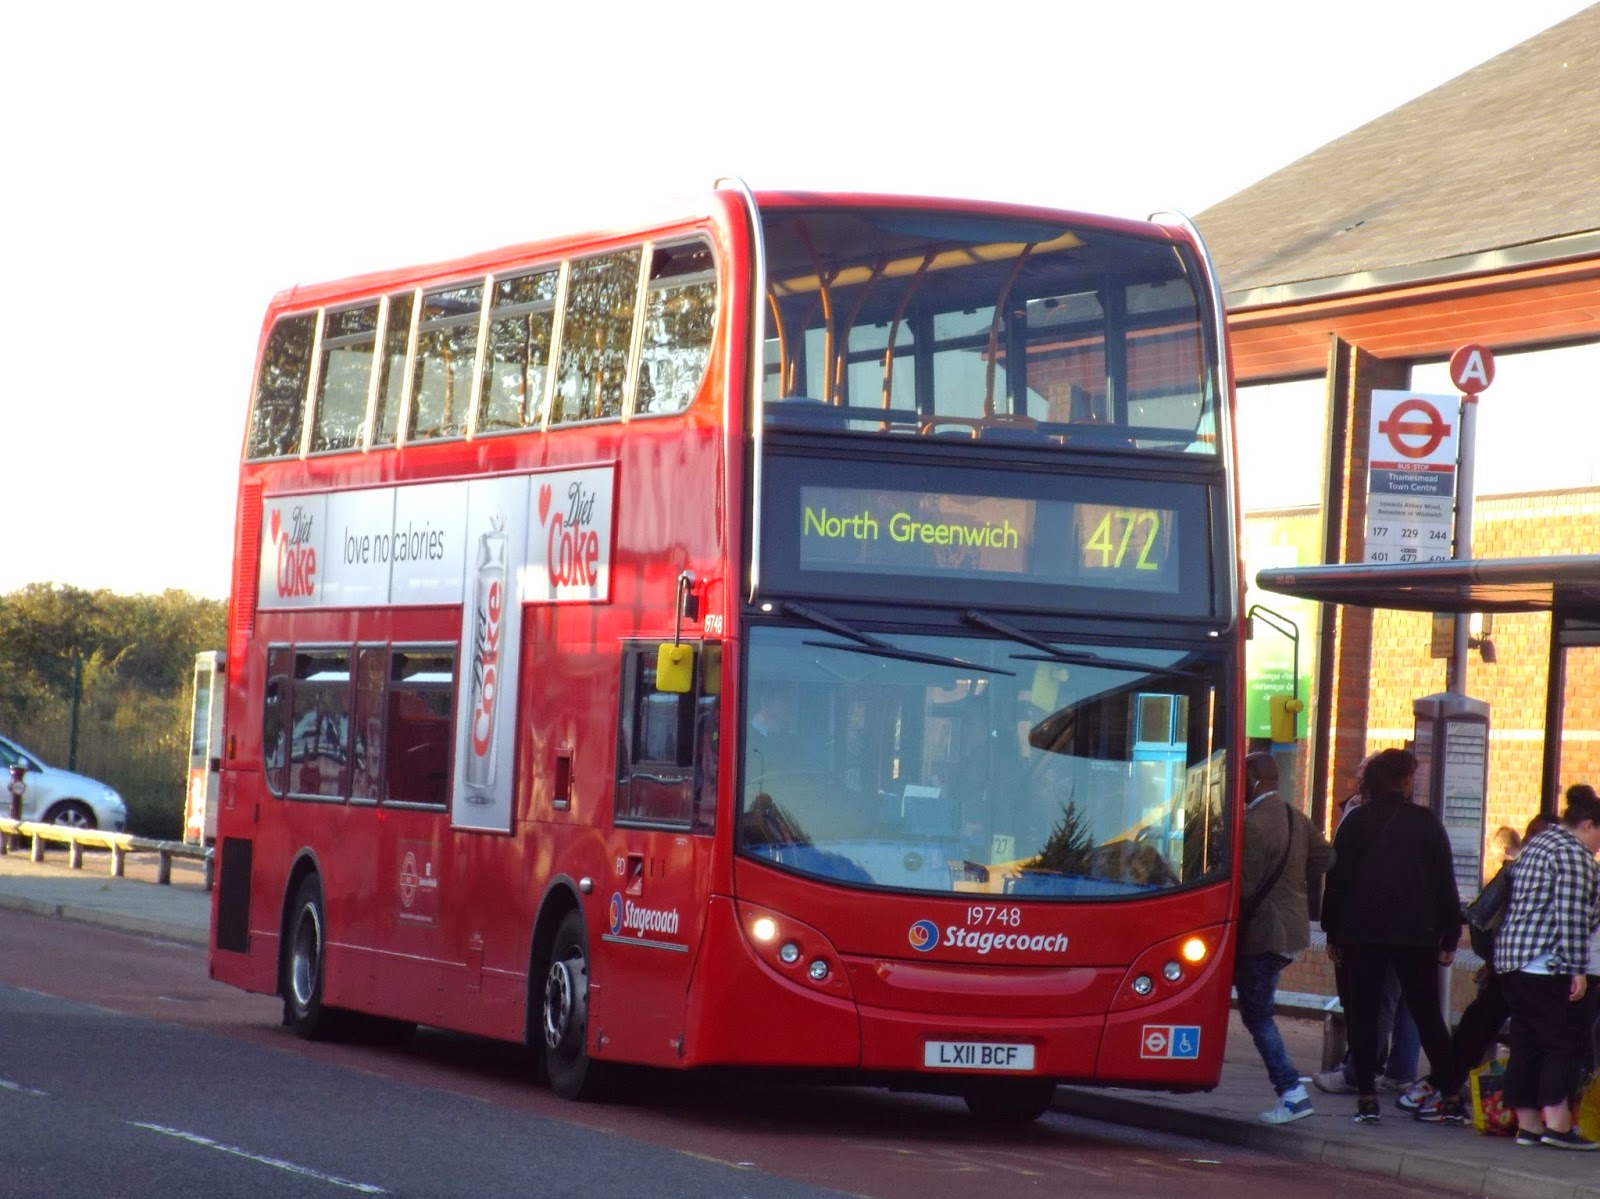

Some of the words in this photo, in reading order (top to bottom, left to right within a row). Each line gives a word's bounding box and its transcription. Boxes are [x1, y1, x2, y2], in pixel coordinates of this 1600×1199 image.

[1458, 350, 1489, 386] A
[1388, 473, 1439, 482] Thamesmead
[1388, 482, 1409, 490] Town
[1410, 483, 1437, 492] Centre
[563, 481, 596, 528] Diet
[289, 505, 313, 546] Diet
[343, 526, 369, 565] love
[373, 534, 389, 564] no
[392, 521, 444, 563] calories
[803, 506, 879, 541] North
[888, 511, 1019, 550] Greenwich
[1085, 510, 1160, 571] 472
[1372, 527, 1389, 537] 177
[1401, 528, 1419, 538] 229
[1429, 530, 1447, 540] 244
[277, 532, 316, 598] Coke
[548, 512, 599, 588] Coke
[1371, 552, 1389, 562] 401
[472, 580, 502, 758] Coke
[623, 900, 680, 938] Stagecoach
[967, 906, 1021, 927] 19748
[943, 925, 1069, 955] Stagecoach
[939, 1043, 975, 1065] LX11
[980, 1045, 1018, 1066] BCF
